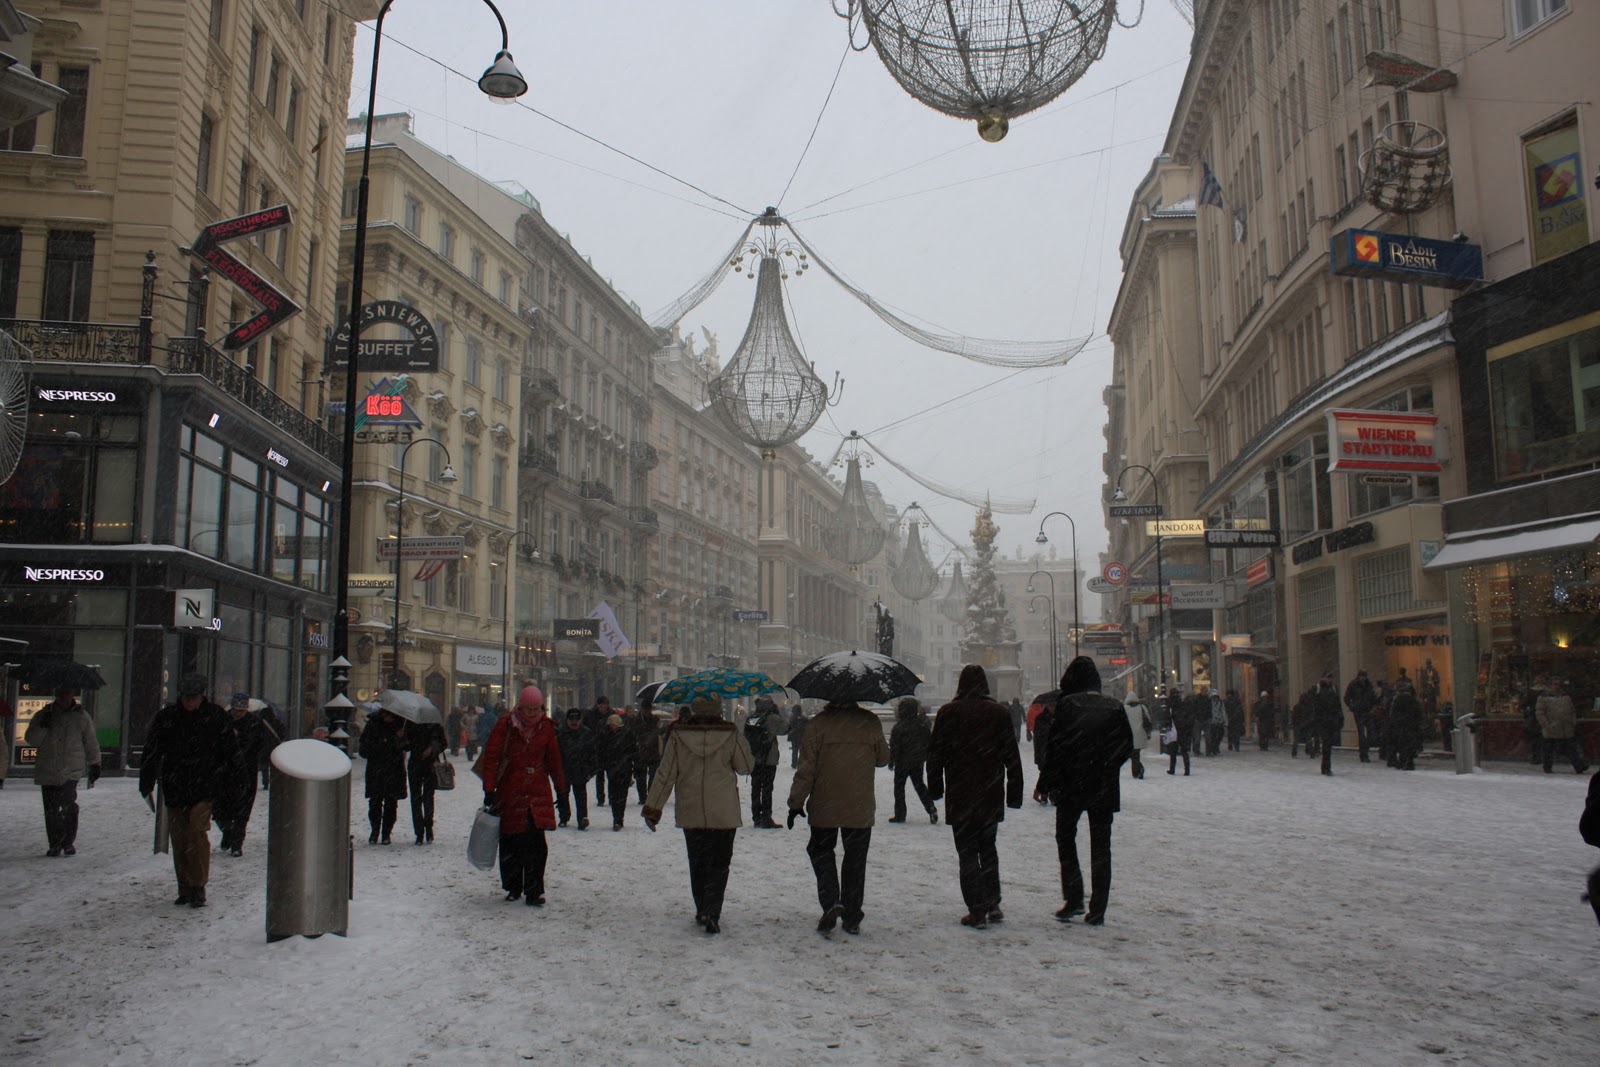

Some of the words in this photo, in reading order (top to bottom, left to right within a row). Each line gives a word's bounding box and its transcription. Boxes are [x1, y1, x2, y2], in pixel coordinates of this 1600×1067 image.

[209, 209, 283, 235] DISCOTHEQUE
[1388, 241, 1437, 270] BESIM
[205, 250, 281, 312] FLEDERMAUS
[248, 315, 270, 332] BAR
[358, 343, 414, 356] BUFFET
[38, 388, 117, 402] NESPRESSO
[366, 395, 402, 416] Köö
[1357, 427, 1416, 442] WIENER
[1207, 531, 1241, 544] GERRY
[1242, 531, 1277, 544] WEBER
[24, 565, 105, 581] NESPRESSO
[1205, 589, 1214, 597] of
[309, 631, 329, 648] FOSSIL
[1384, 635, 1428, 646] GERRY
[467, 653, 498, 667] ALESSIO
